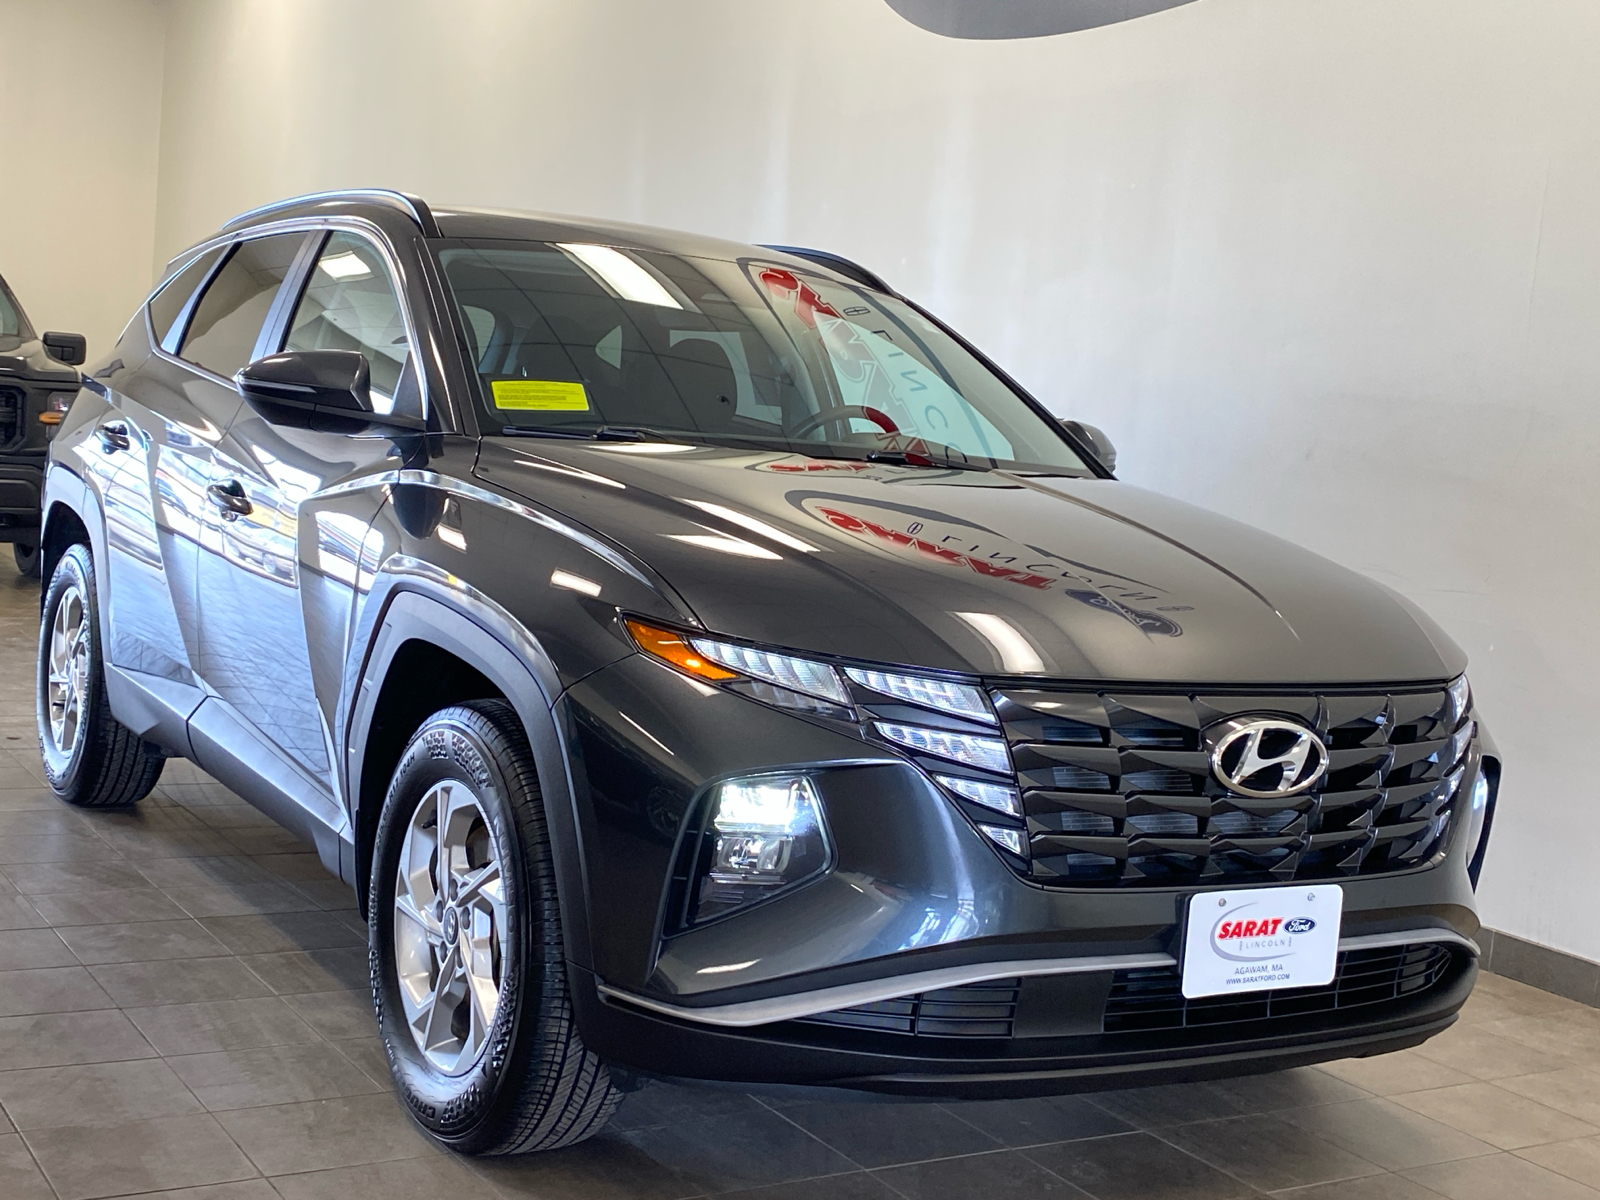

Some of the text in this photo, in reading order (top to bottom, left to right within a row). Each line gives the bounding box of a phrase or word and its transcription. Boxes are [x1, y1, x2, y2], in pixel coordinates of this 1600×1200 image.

[1217, 917, 1313, 940] SARAT Ford
[1245, 939, 1286, 949] LINCOLN
[1271, 963, 1284, 972] MA
